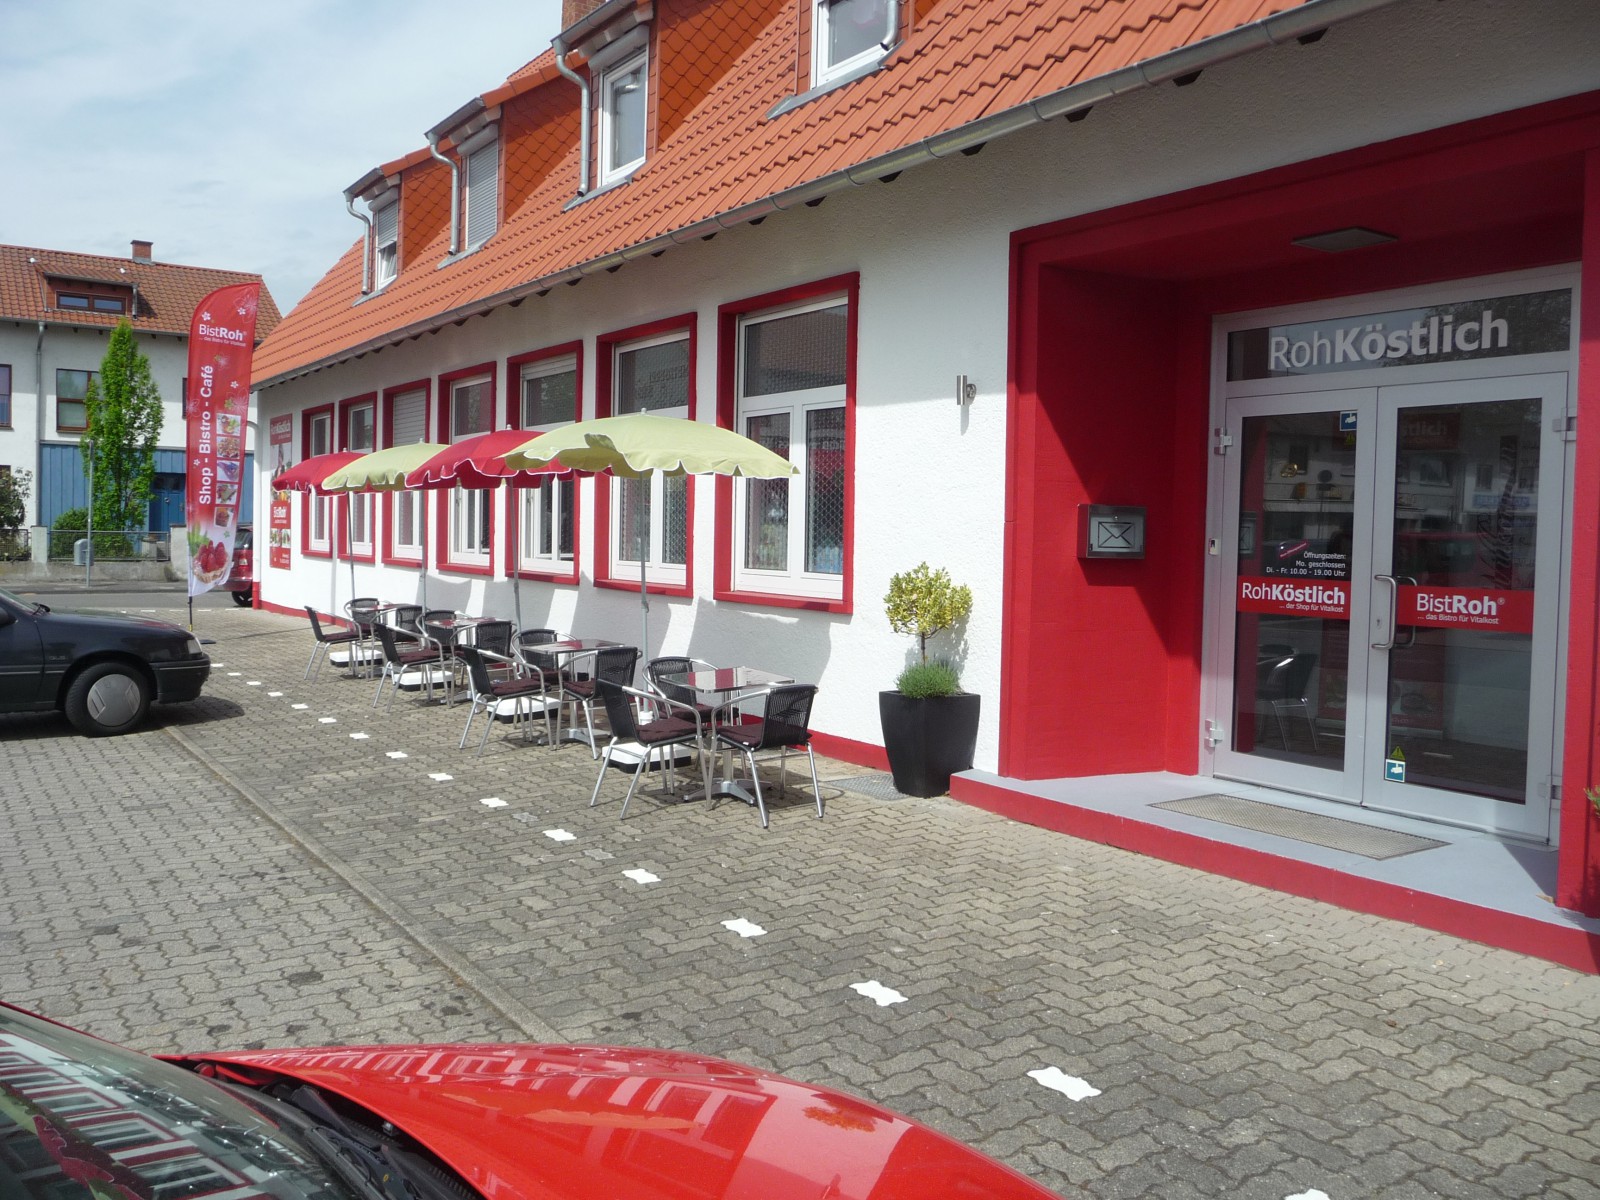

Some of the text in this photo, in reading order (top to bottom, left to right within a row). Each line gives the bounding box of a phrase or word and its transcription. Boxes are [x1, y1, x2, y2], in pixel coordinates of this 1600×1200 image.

[1269, 310, 1509, 370] RohKöstlich
[200, 365, 214, 398] Café
[199, 411, 211, 454] Bistro
[199, 467, 213, 505] Shop
[1308, 561, 1346, 569] geschlossen
[1242, 582, 1345, 605] RohKöstlich
[1296, 603, 1309, 611] Shop
[1320, 605, 1344, 613] Vitalkost
[1438, 614, 1457, 622] Bistro
[1459, 615, 1468, 623] für
[1470, 616, 1499, 625] Vitalkost
